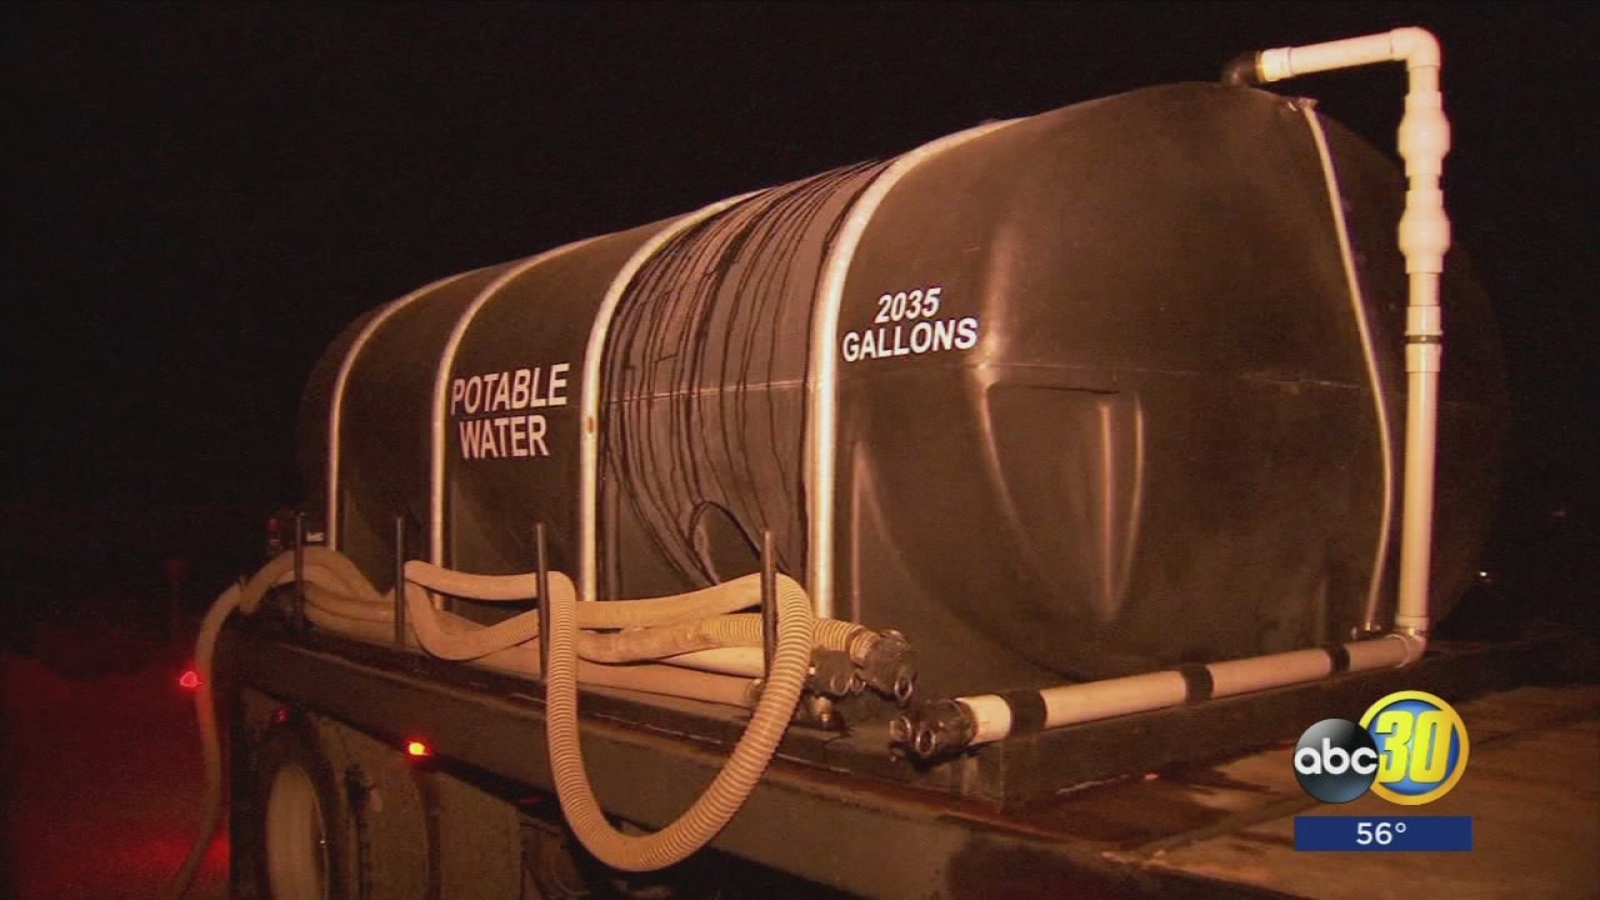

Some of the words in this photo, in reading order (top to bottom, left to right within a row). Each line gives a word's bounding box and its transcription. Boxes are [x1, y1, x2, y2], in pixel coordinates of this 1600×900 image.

[874, 287, 942, 324] 2035
[843, 317, 977, 362] GALLONS
[450, 363, 570, 415] POTABLE
[459, 415, 549, 459] WATER
